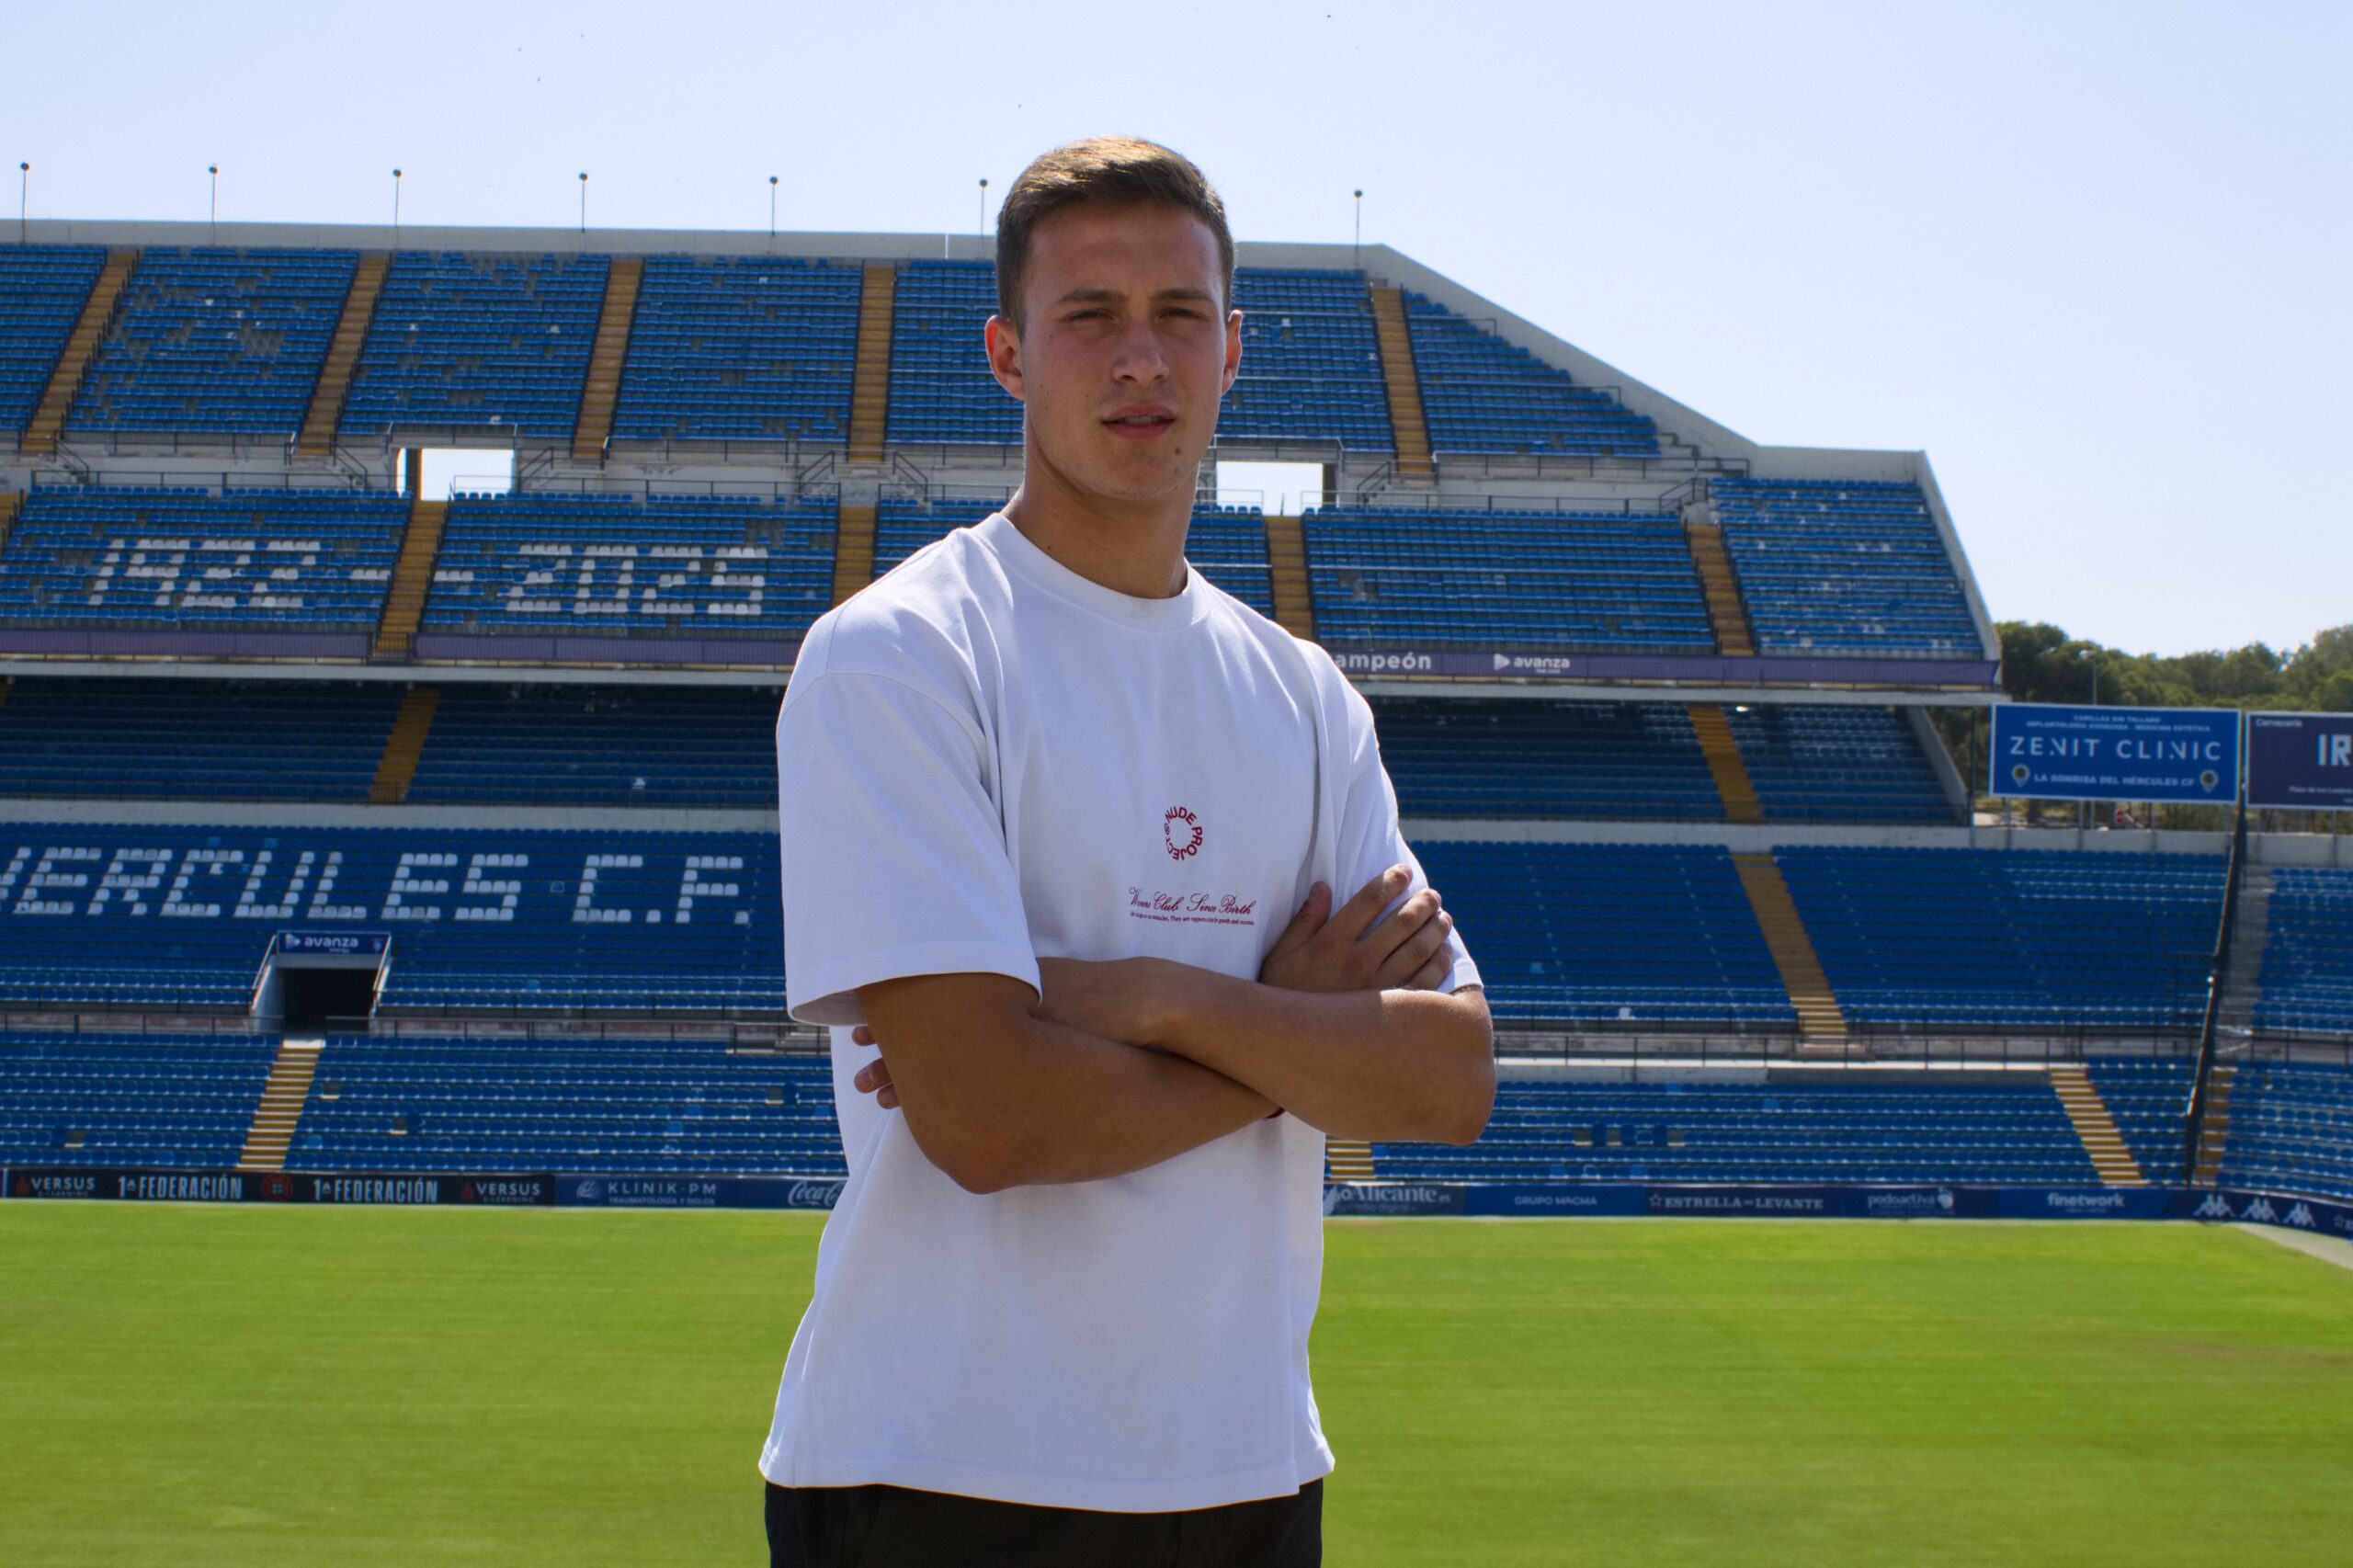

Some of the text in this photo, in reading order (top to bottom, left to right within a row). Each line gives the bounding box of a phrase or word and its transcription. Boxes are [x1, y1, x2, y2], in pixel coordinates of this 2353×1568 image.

[506, 544, 768, 615] 2025
[1335, 652, 1431, 672] ampeón
[1513, 657, 1570, 669] avanza
[2010, 736, 2222, 761] ZENIT CLINIC
[2034, 774, 2048, 782] LA
[2051, 775, 2097, 784] SONRISA
[2099, 776, 2120, 785] DEL
[1165, 806, 1203, 861] NUDE PROJECT
[1154, 891, 1185, 911] Club
[1186, 892, 1217, 913] Since
[1219, 894, 1257, 915] Birth
[304, 937, 358, 948] avanza
[31, 1176, 95, 1190] VERSUS
[139, 1174, 243, 1199] FEDERACIÓN
[335, 1176, 438, 1203] FEDERACIÓN
[476, 1182, 541, 1196] VERSUS
[1514, 1196, 1553, 1206] GRUPO
[1665, 1197, 1742, 1209] ESTRELLA
[1756, 1198, 1824, 1210] LEVANTE
[2047, 1192, 2125, 1207] finetwork
